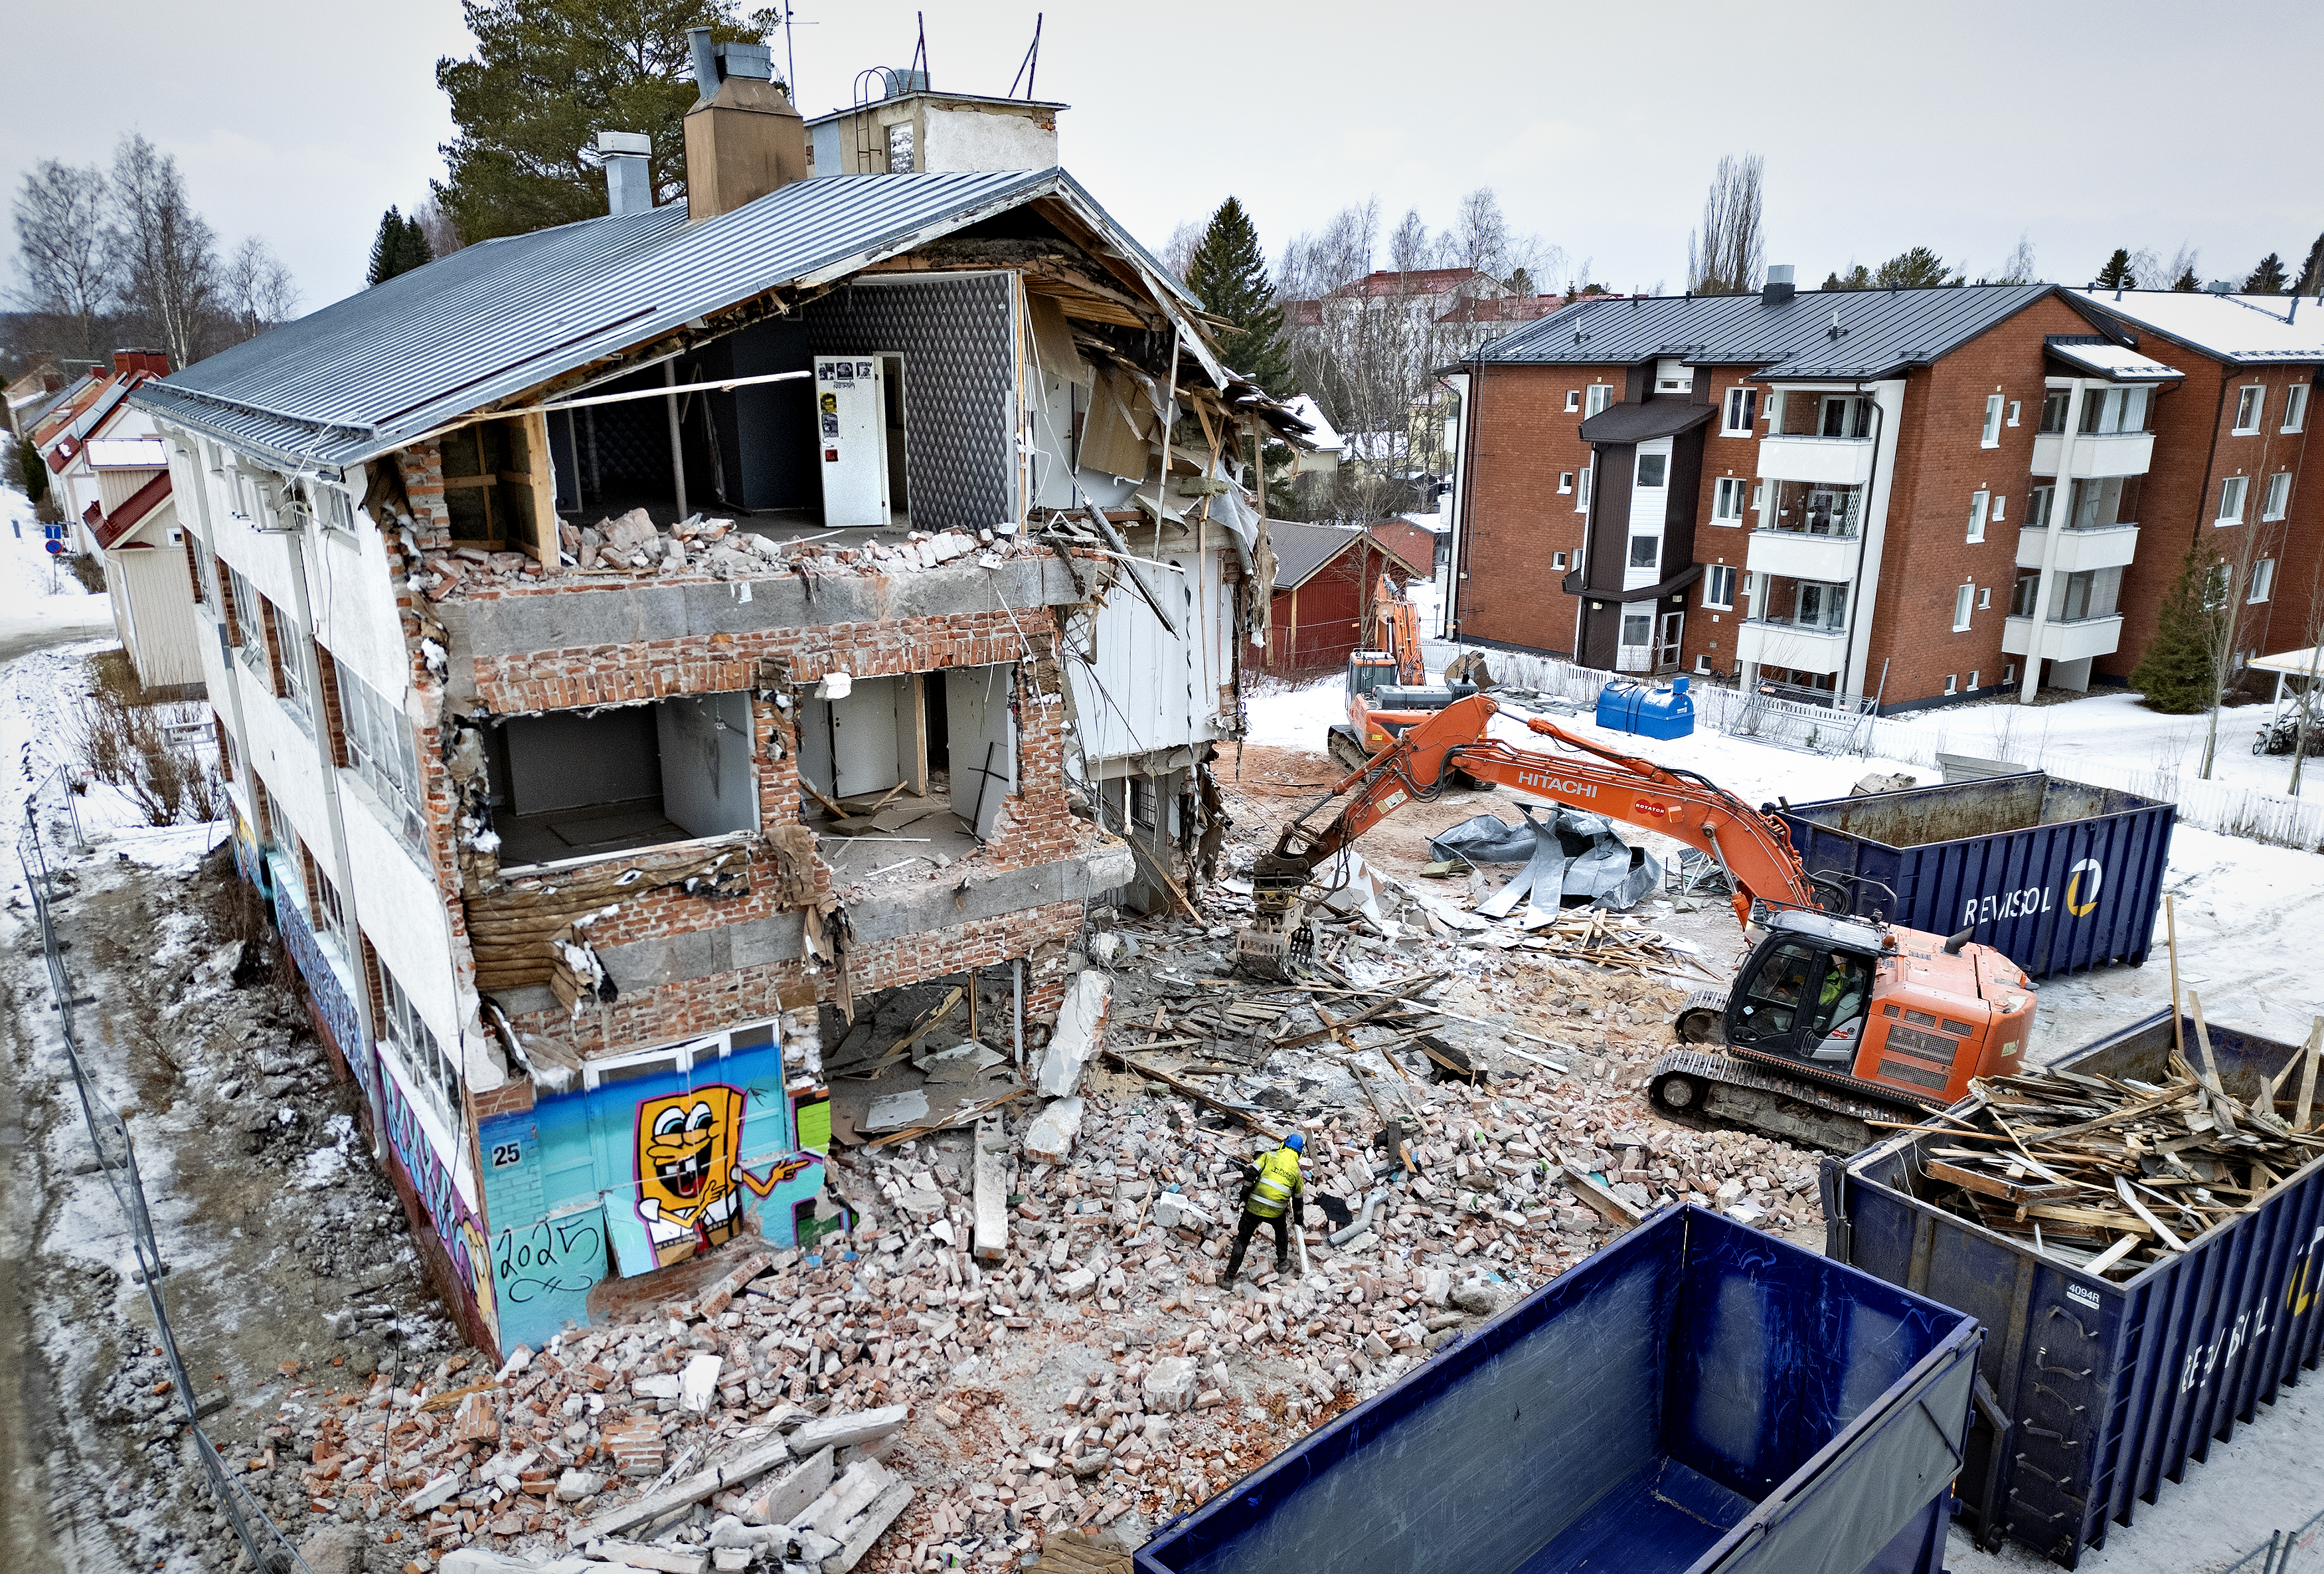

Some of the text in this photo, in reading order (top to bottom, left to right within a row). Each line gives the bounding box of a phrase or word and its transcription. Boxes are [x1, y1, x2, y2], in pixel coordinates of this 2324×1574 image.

[1519, 772, 1598, 798] HITACHI
[1635, 804, 1665, 814] ROTATOR
[1963, 887, 2051, 926] REVISOL
[493, 1143, 521, 1166] 25
[497, 1219, 599, 1278] 2025
[2068, 1284, 2100, 1303] 4094R
